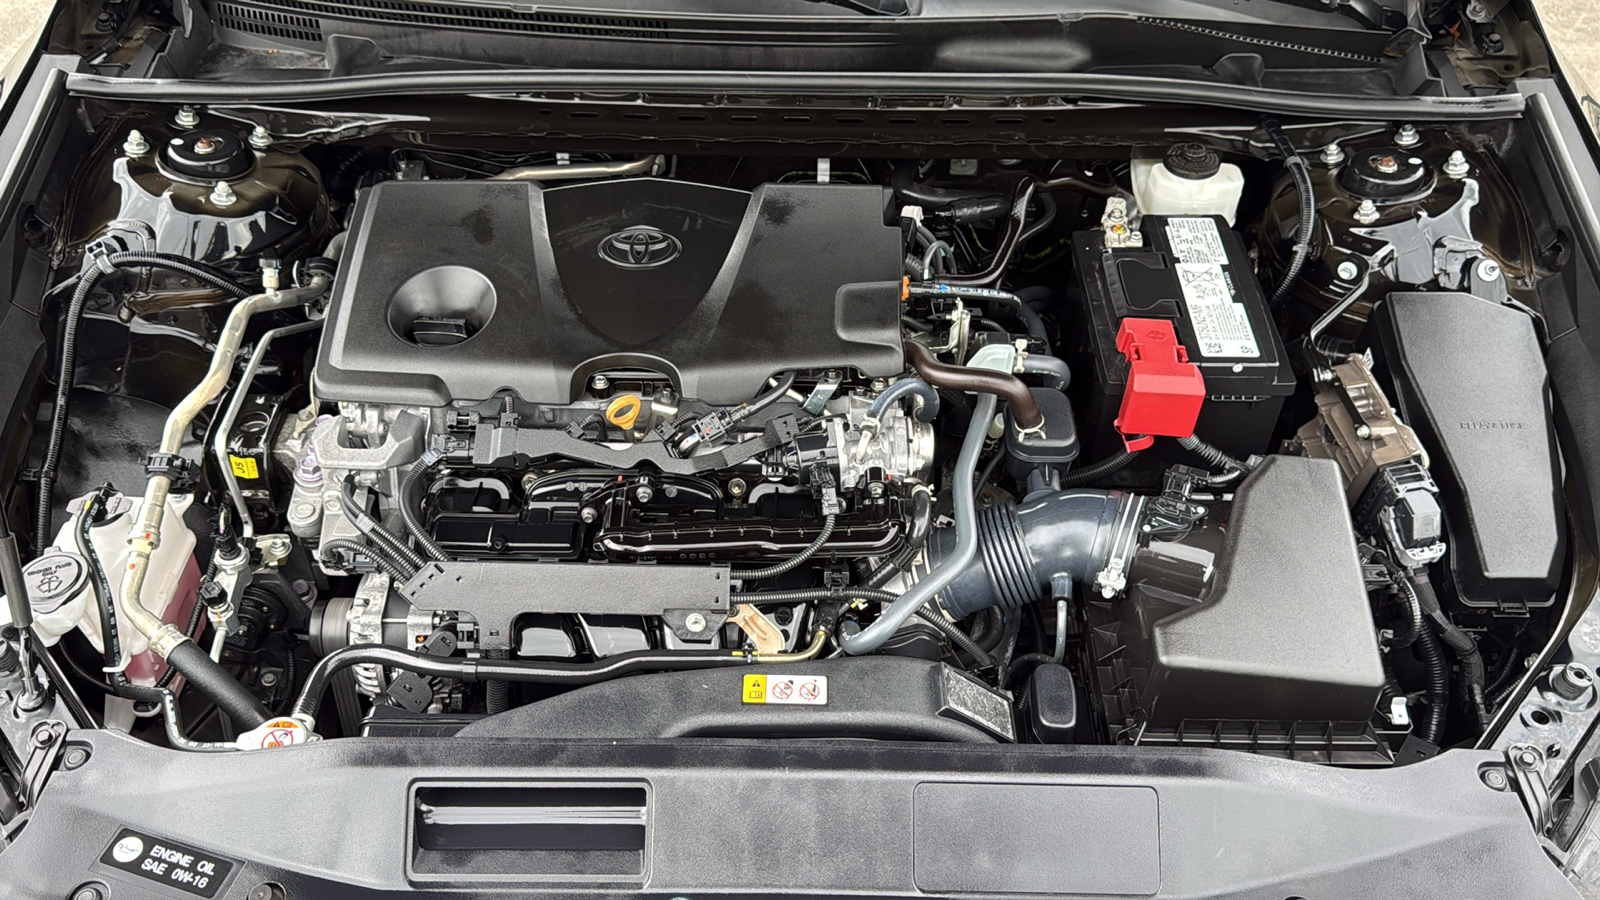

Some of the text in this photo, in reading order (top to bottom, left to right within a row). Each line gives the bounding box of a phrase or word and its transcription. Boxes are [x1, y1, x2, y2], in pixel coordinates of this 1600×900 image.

[141, 858, 209, 889] SAE 0W-16
[150, 845, 215, 875] ENGINE OIL
